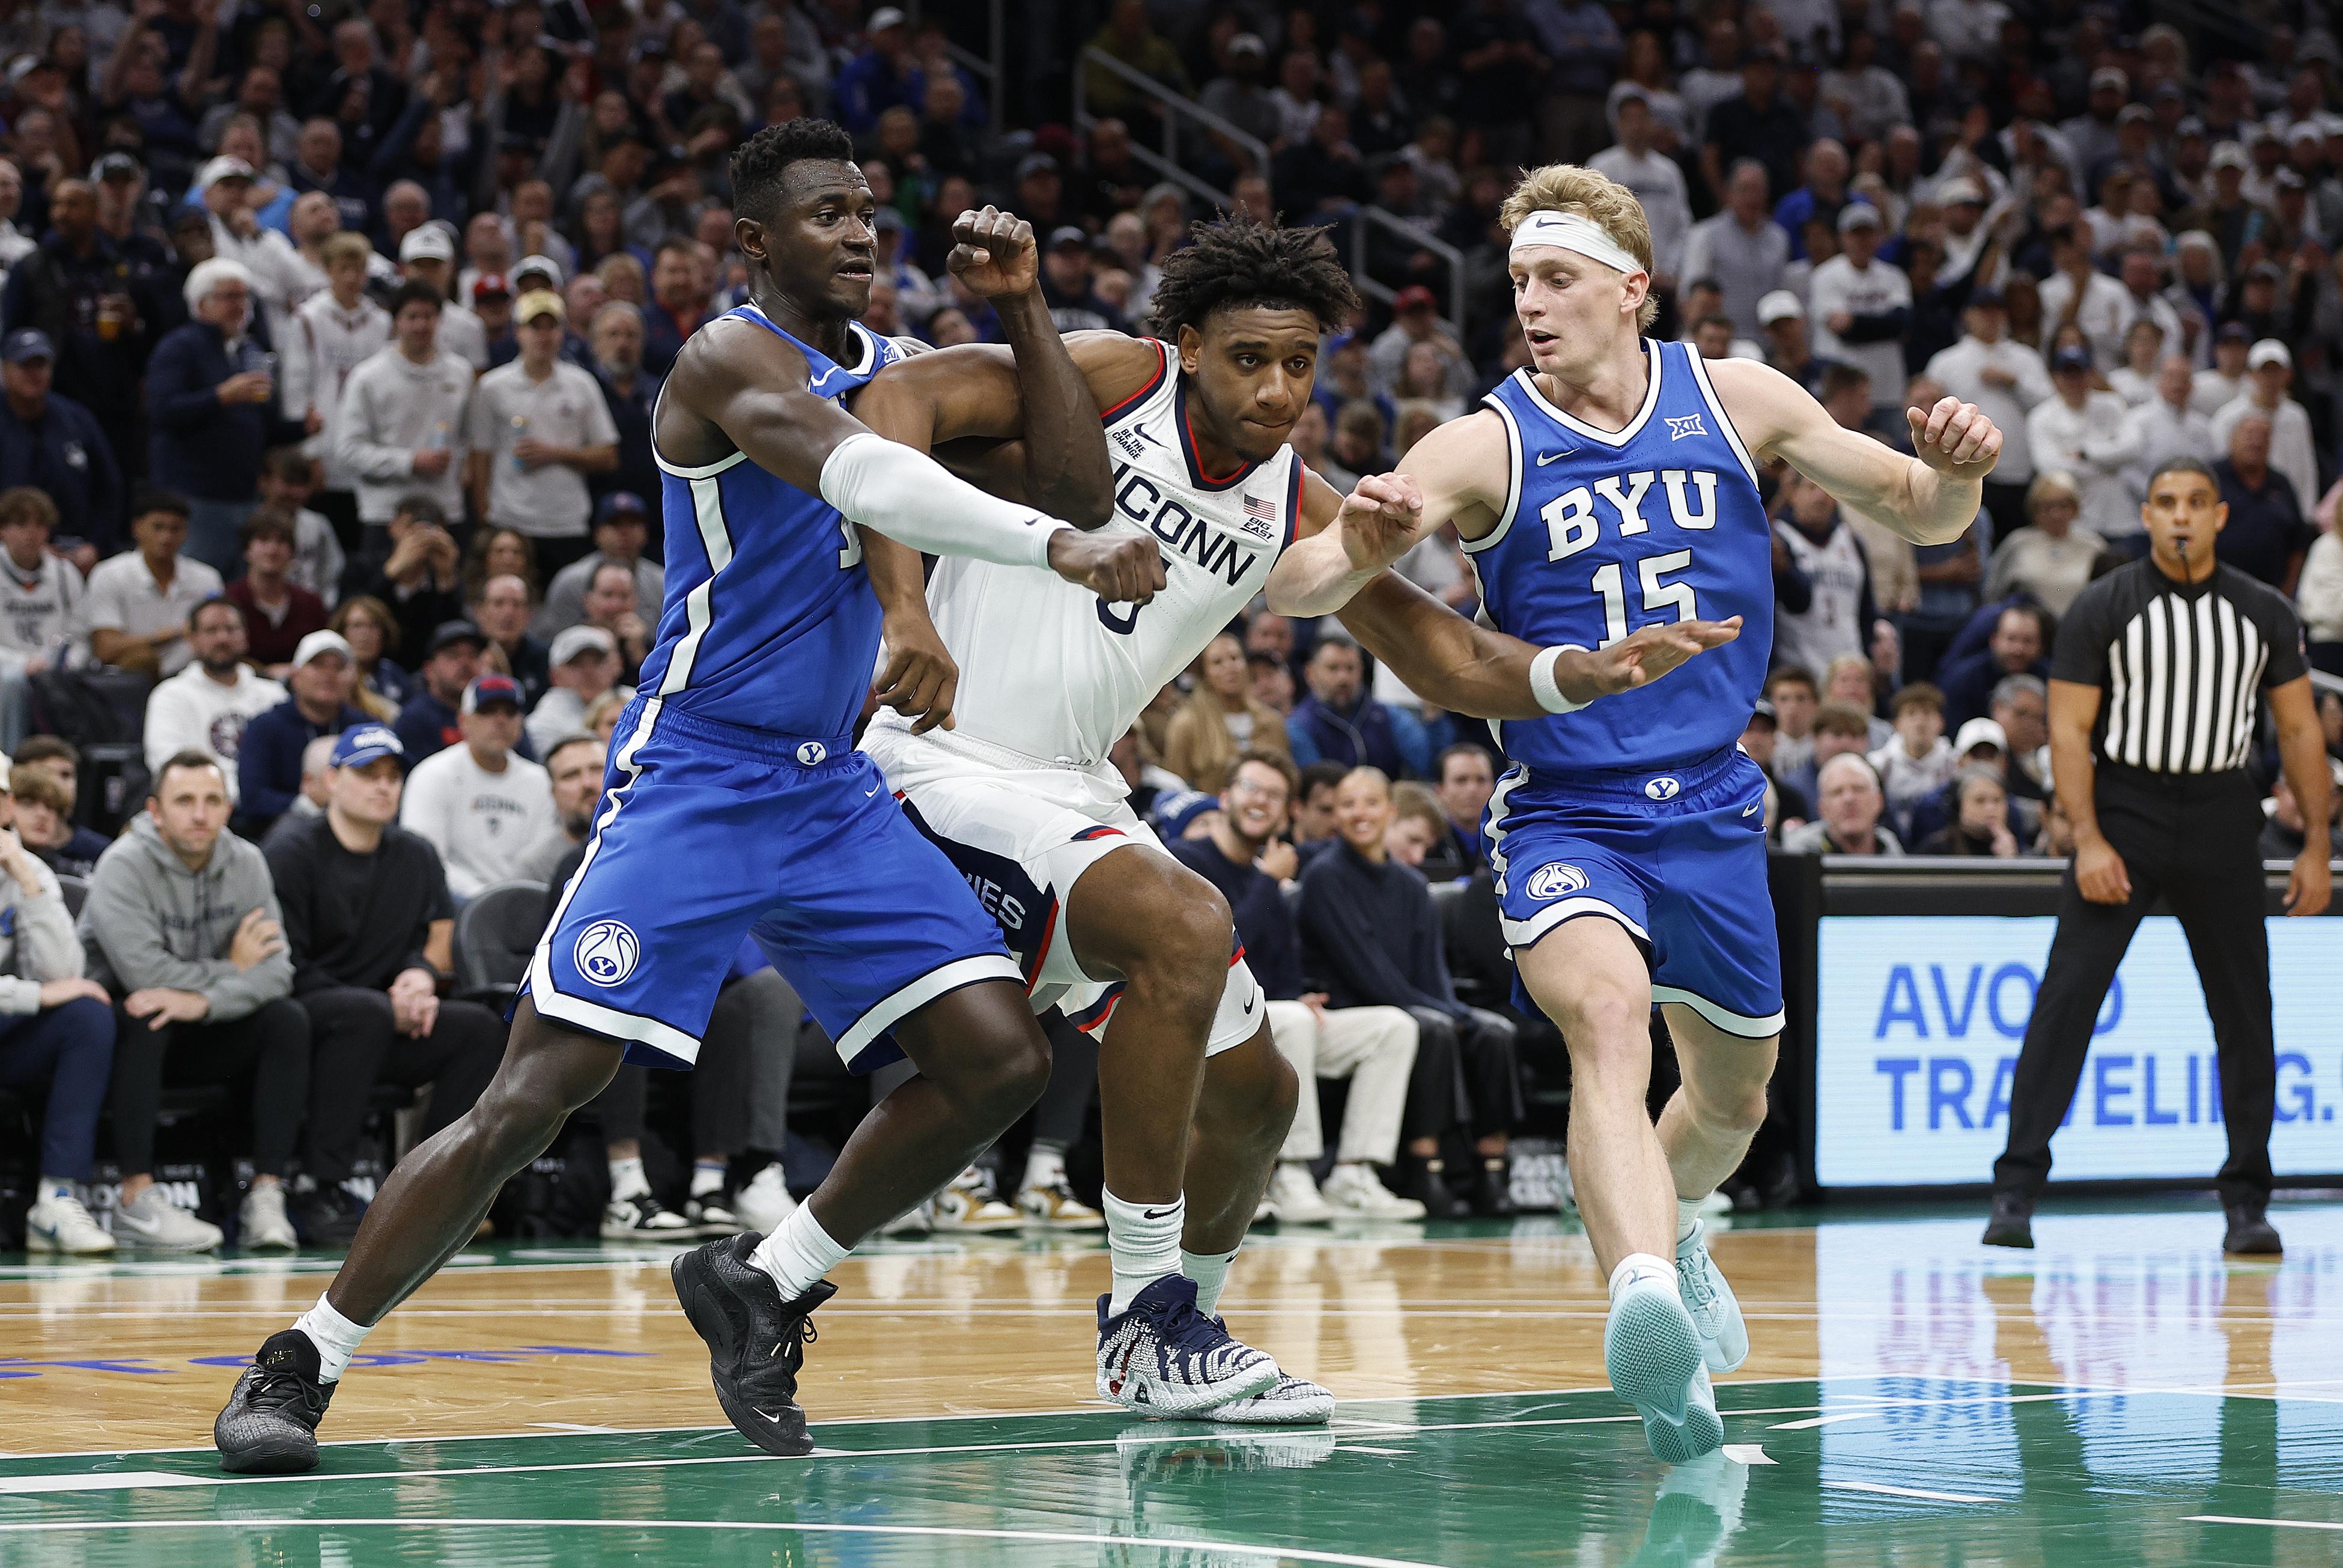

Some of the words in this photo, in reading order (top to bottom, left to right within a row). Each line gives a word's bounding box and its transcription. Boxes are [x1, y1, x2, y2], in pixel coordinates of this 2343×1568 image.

[1112, 432, 1141, 460] CHANGE
[1120, 428, 1134, 440] BE
[1131, 439, 1146, 454] THE
[1249, 517, 1272, 530] BIG
[1540, 469, 1719, 563] BYU
[1244, 522, 1275, 539] EAST
[1591, 548, 1699, 651] 15
[803, 744, 822, 764] Y
[1651, 780, 1674, 798] Y
[1876, 964, 2123, 1038] AVOD
